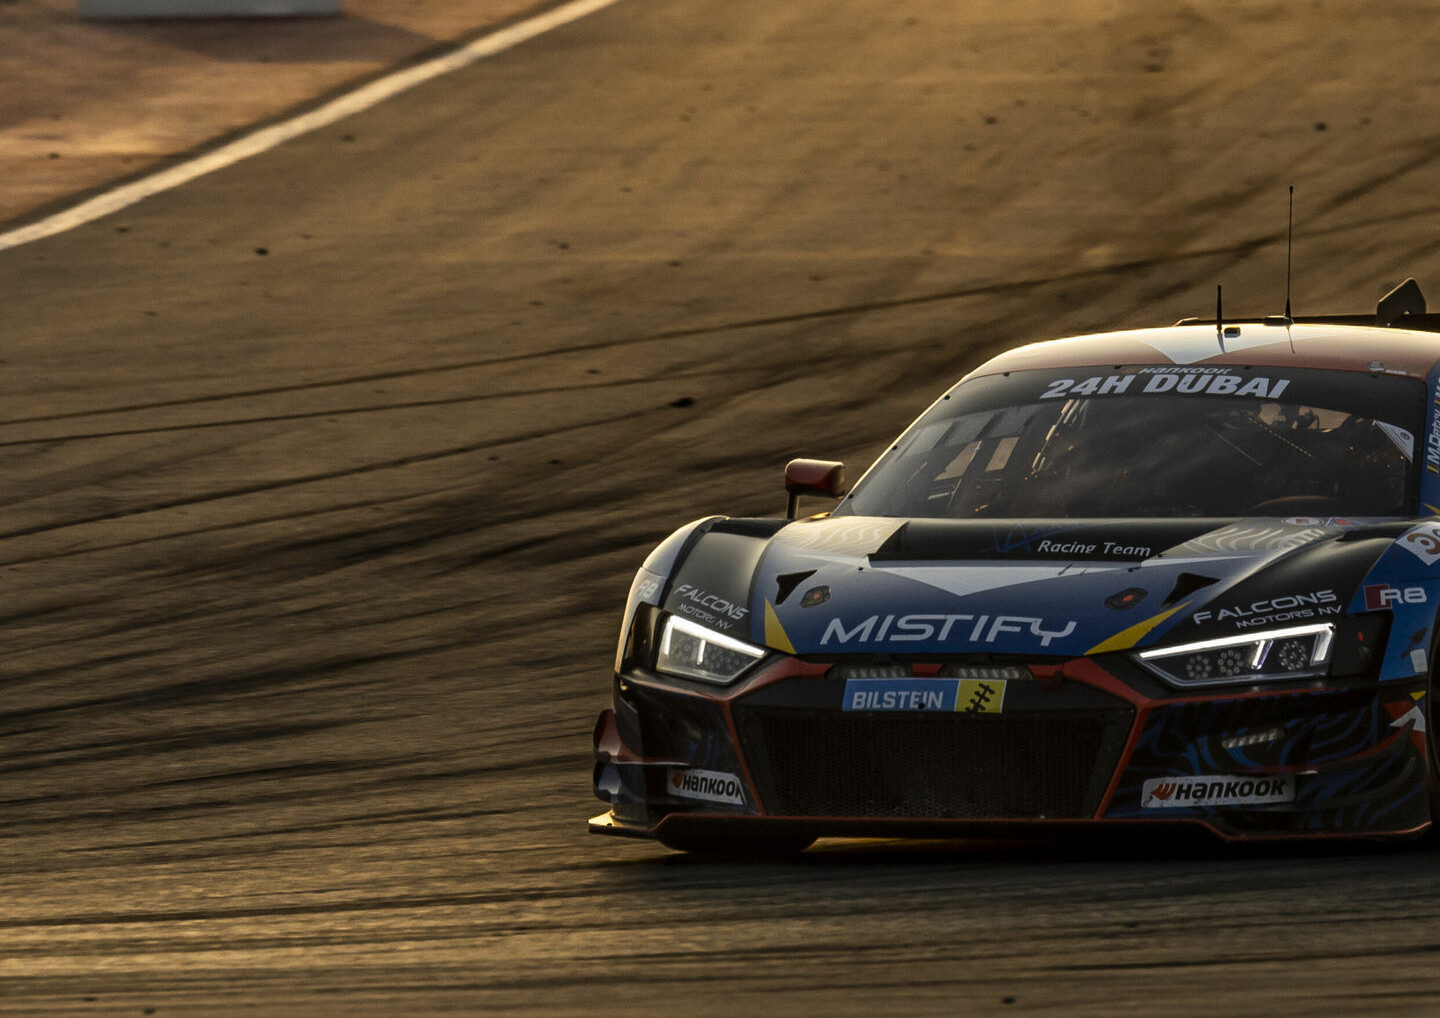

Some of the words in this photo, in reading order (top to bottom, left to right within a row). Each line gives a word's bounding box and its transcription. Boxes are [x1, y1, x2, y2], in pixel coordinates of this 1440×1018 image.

[1039, 374, 1136, 399] 24H
[1143, 373, 1291, 399] DUBAI
[1037, 539, 1097, 554] Racing
[1103, 541, 1151, 557] Team
[674, 584, 749, 620] FALCONS
[1193, 590, 1337, 624] FALCONS
[1379, 587, 1427, 606] R8
[679, 602, 716, 624] MOTORS
[1235, 608, 1314, 629] MOTORS
[1319, 604, 1342, 616] NV
[819, 614, 1077, 647] MISTIFY
[852, 690, 944, 710] BILSTEIN
